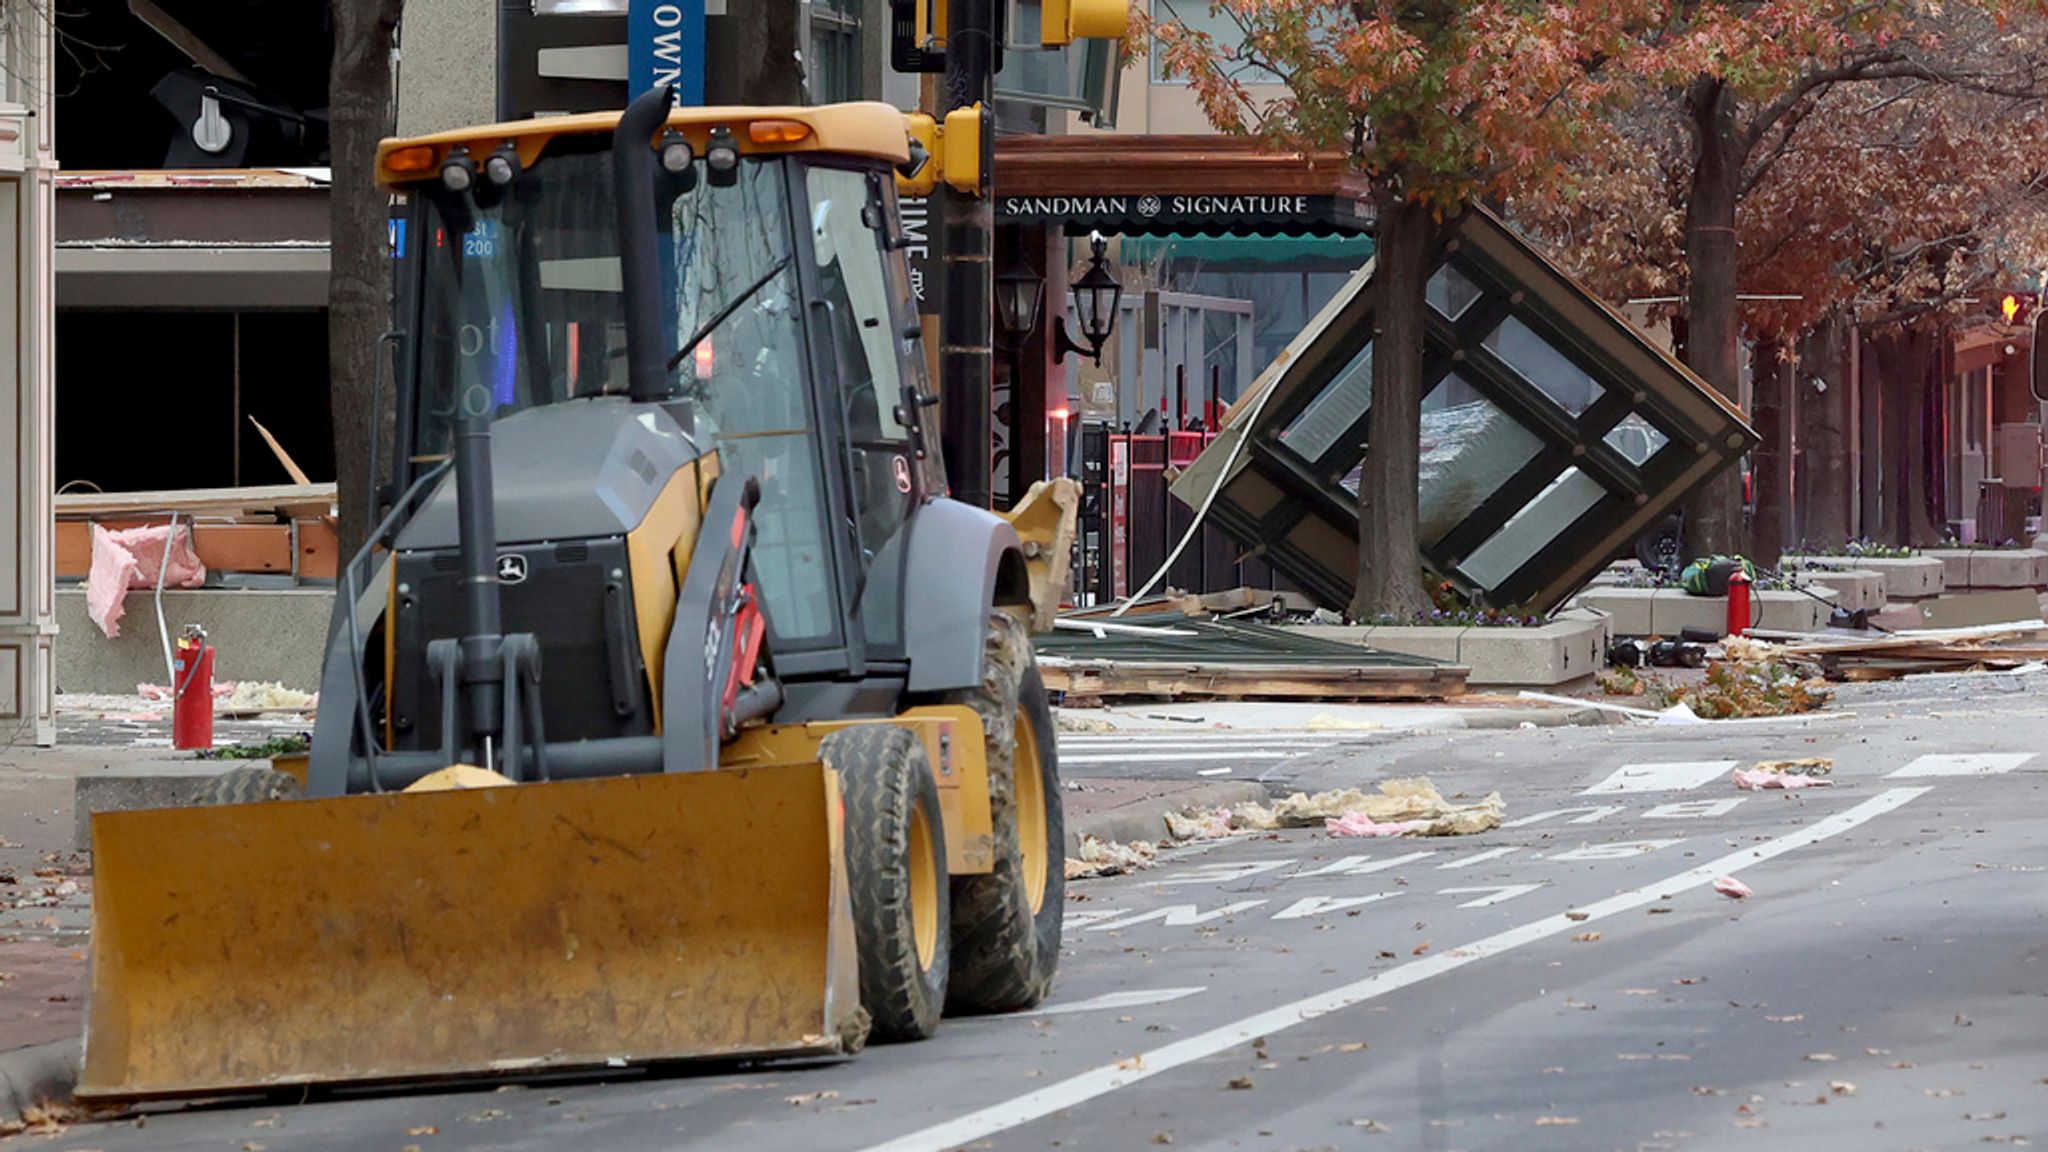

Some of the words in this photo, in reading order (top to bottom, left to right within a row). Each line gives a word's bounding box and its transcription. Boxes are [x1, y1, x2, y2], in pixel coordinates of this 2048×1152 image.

[1006, 196, 1127, 215] SANDMAN
[1171, 196, 1308, 214] SIGNATURE
[465, 240, 493, 256] 200
